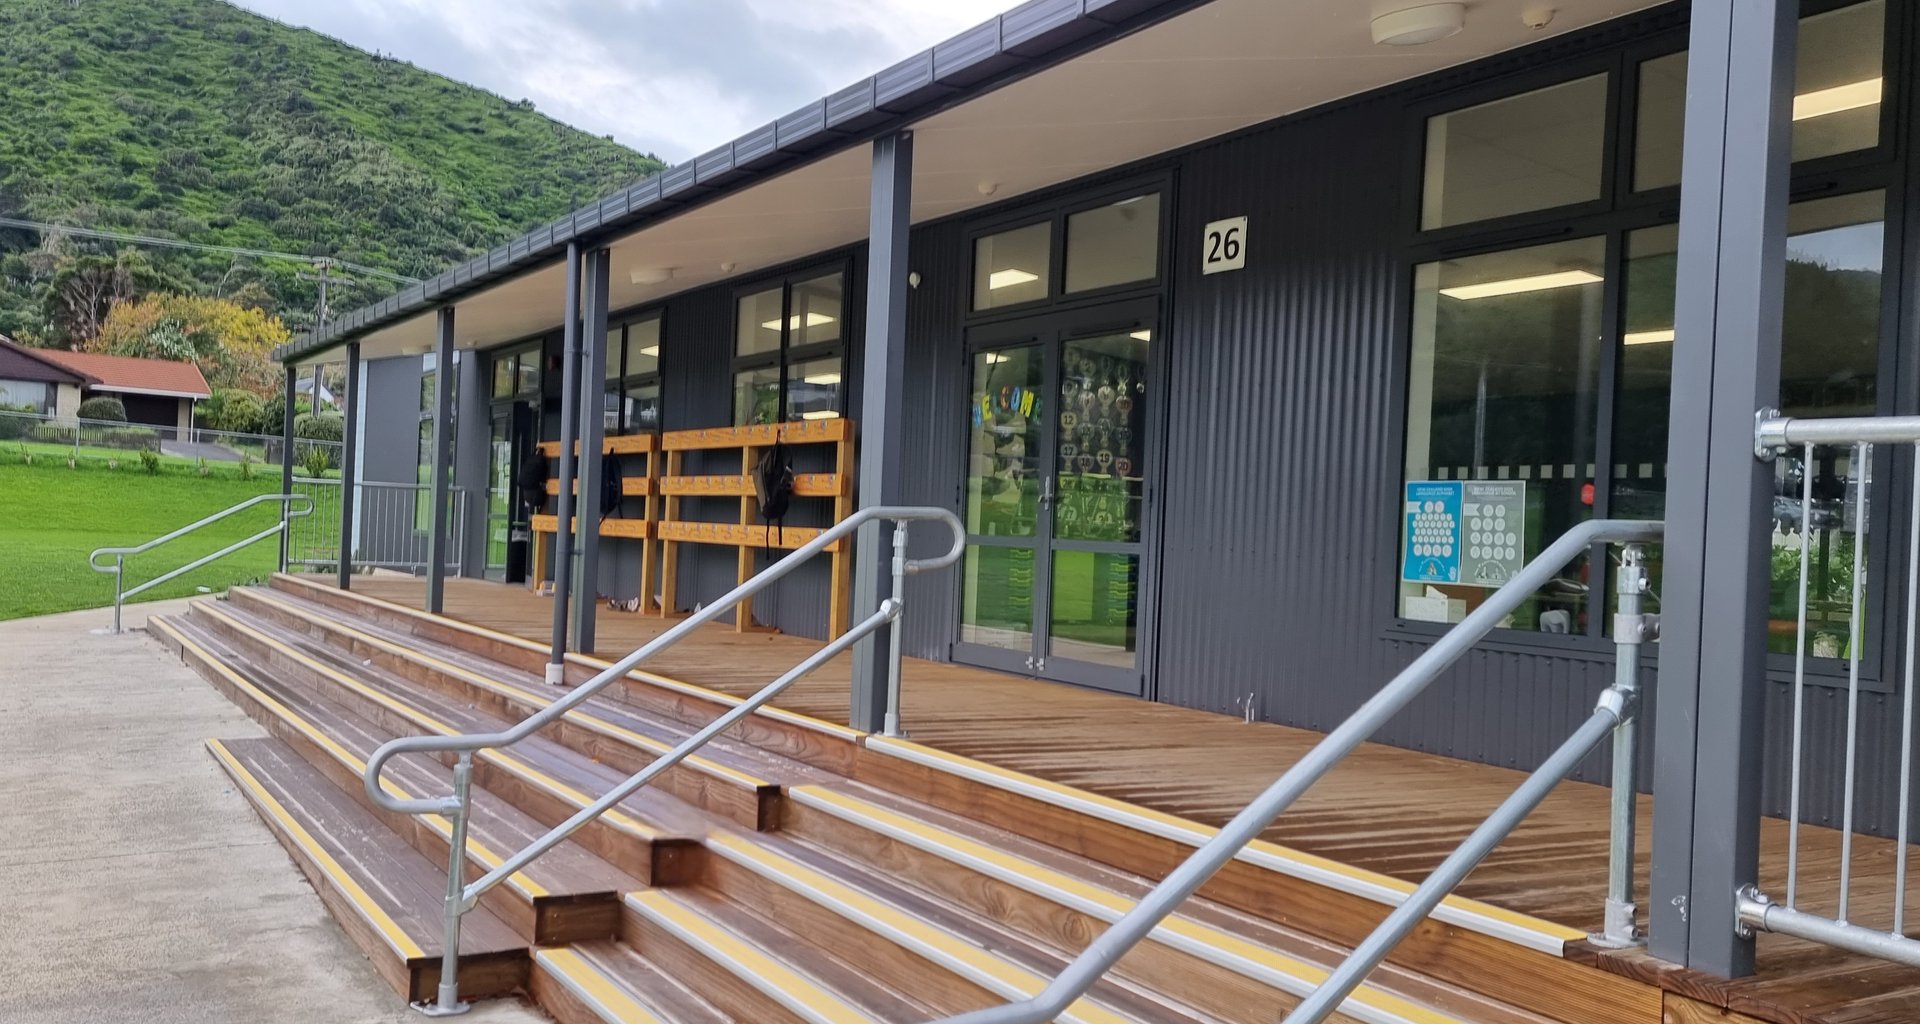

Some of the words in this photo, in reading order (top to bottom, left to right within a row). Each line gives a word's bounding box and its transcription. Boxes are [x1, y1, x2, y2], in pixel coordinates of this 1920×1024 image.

[1208, 228, 1239, 263] 26
[1064, 415, 1074, 425] 12
[1063, 446, 1074, 456] 17
[1099, 453, 1110, 463] 19
